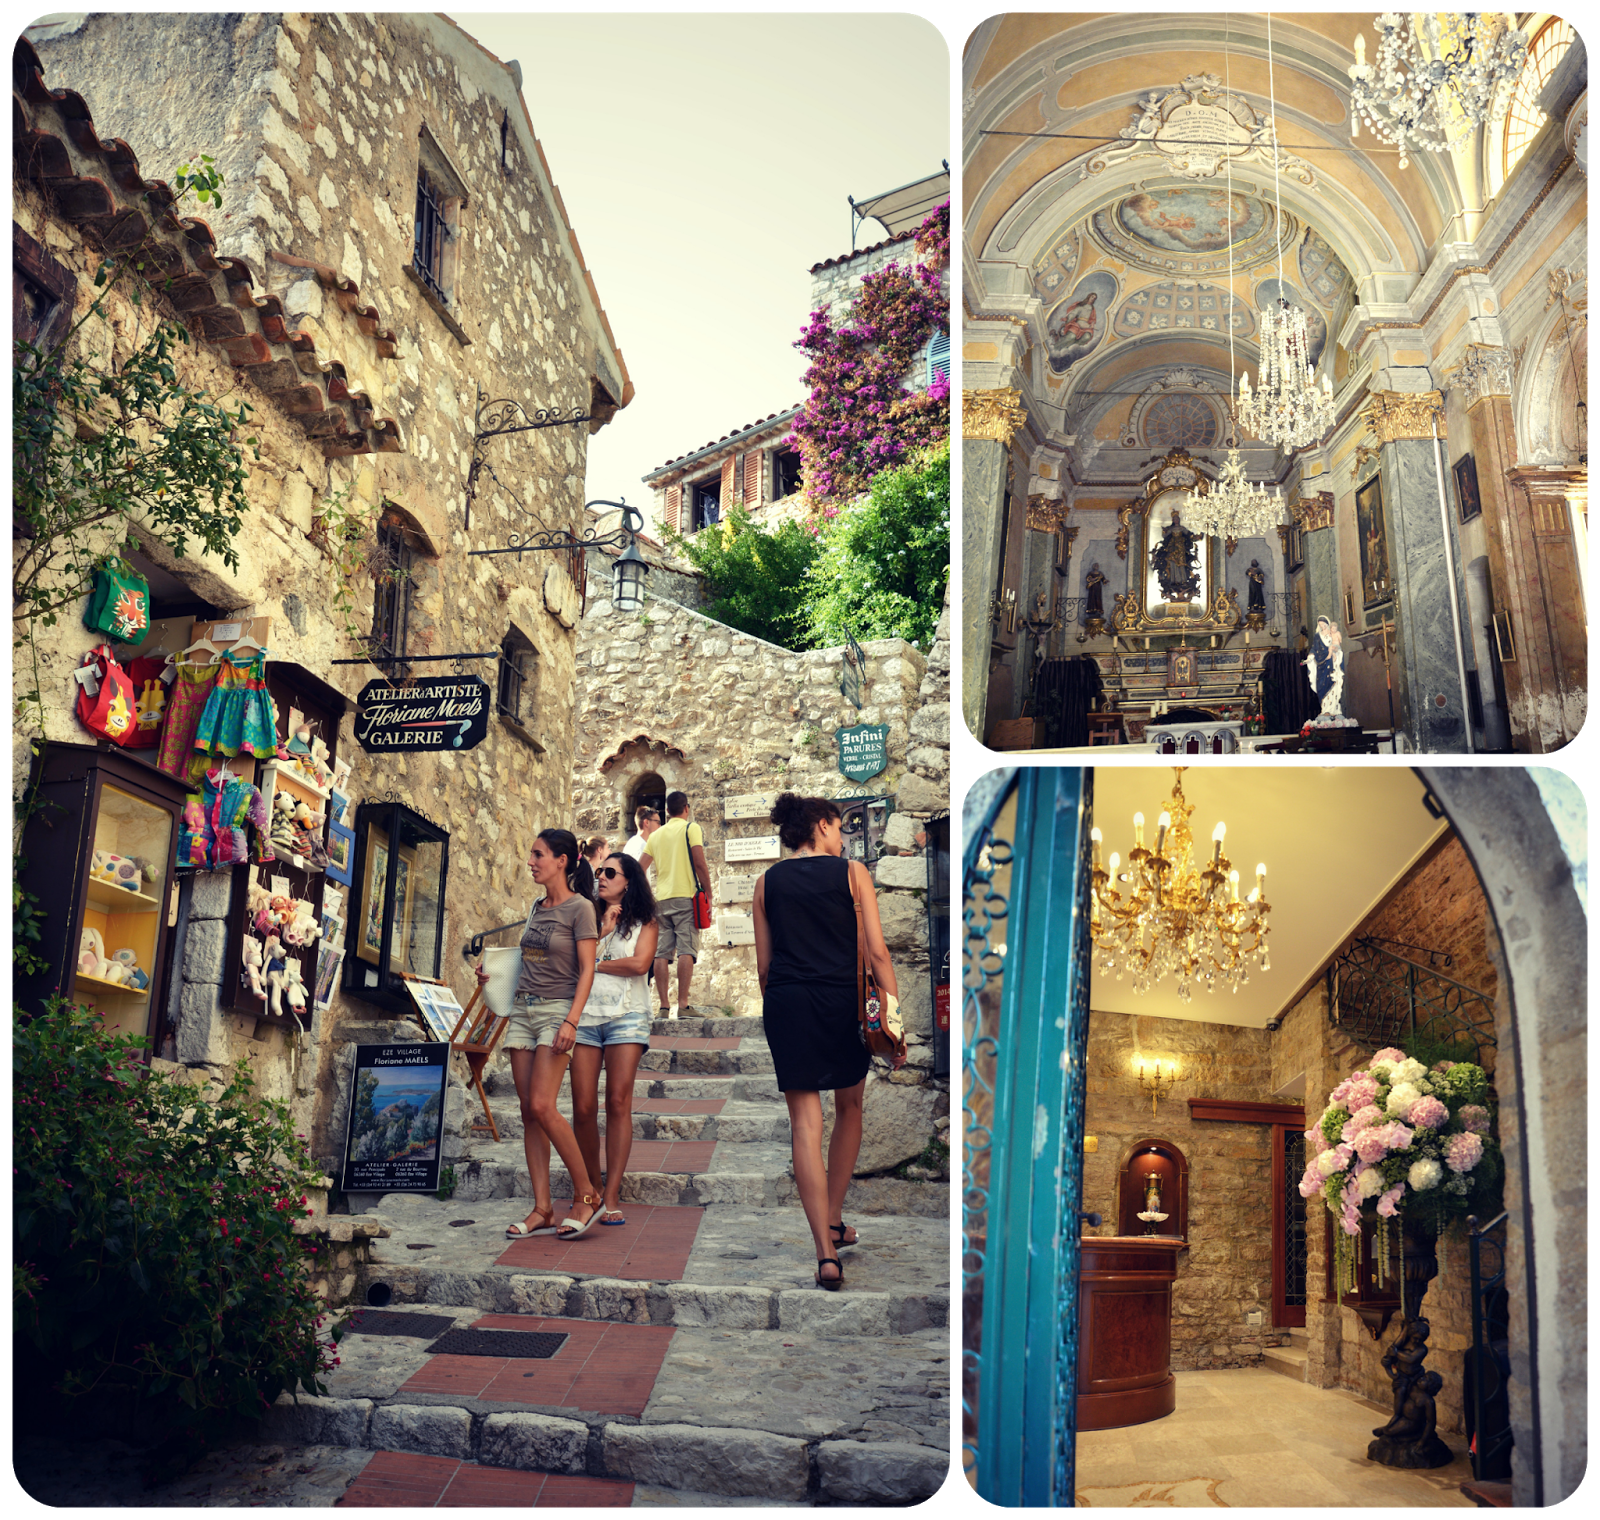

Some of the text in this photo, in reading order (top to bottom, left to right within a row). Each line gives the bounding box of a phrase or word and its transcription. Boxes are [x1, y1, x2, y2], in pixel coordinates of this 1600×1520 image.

[364, 687, 421, 701] ATELIER
[358, 697, 483, 740] Floriane Maels
[369, 730, 444, 746] GALERIE
[841, 729, 883, 745] Infini
[843, 742, 882, 754] PARURES
[396, 1048, 422, 1056] VILLAGE
[374, 1056, 429, 1065] Floriane MAELS
